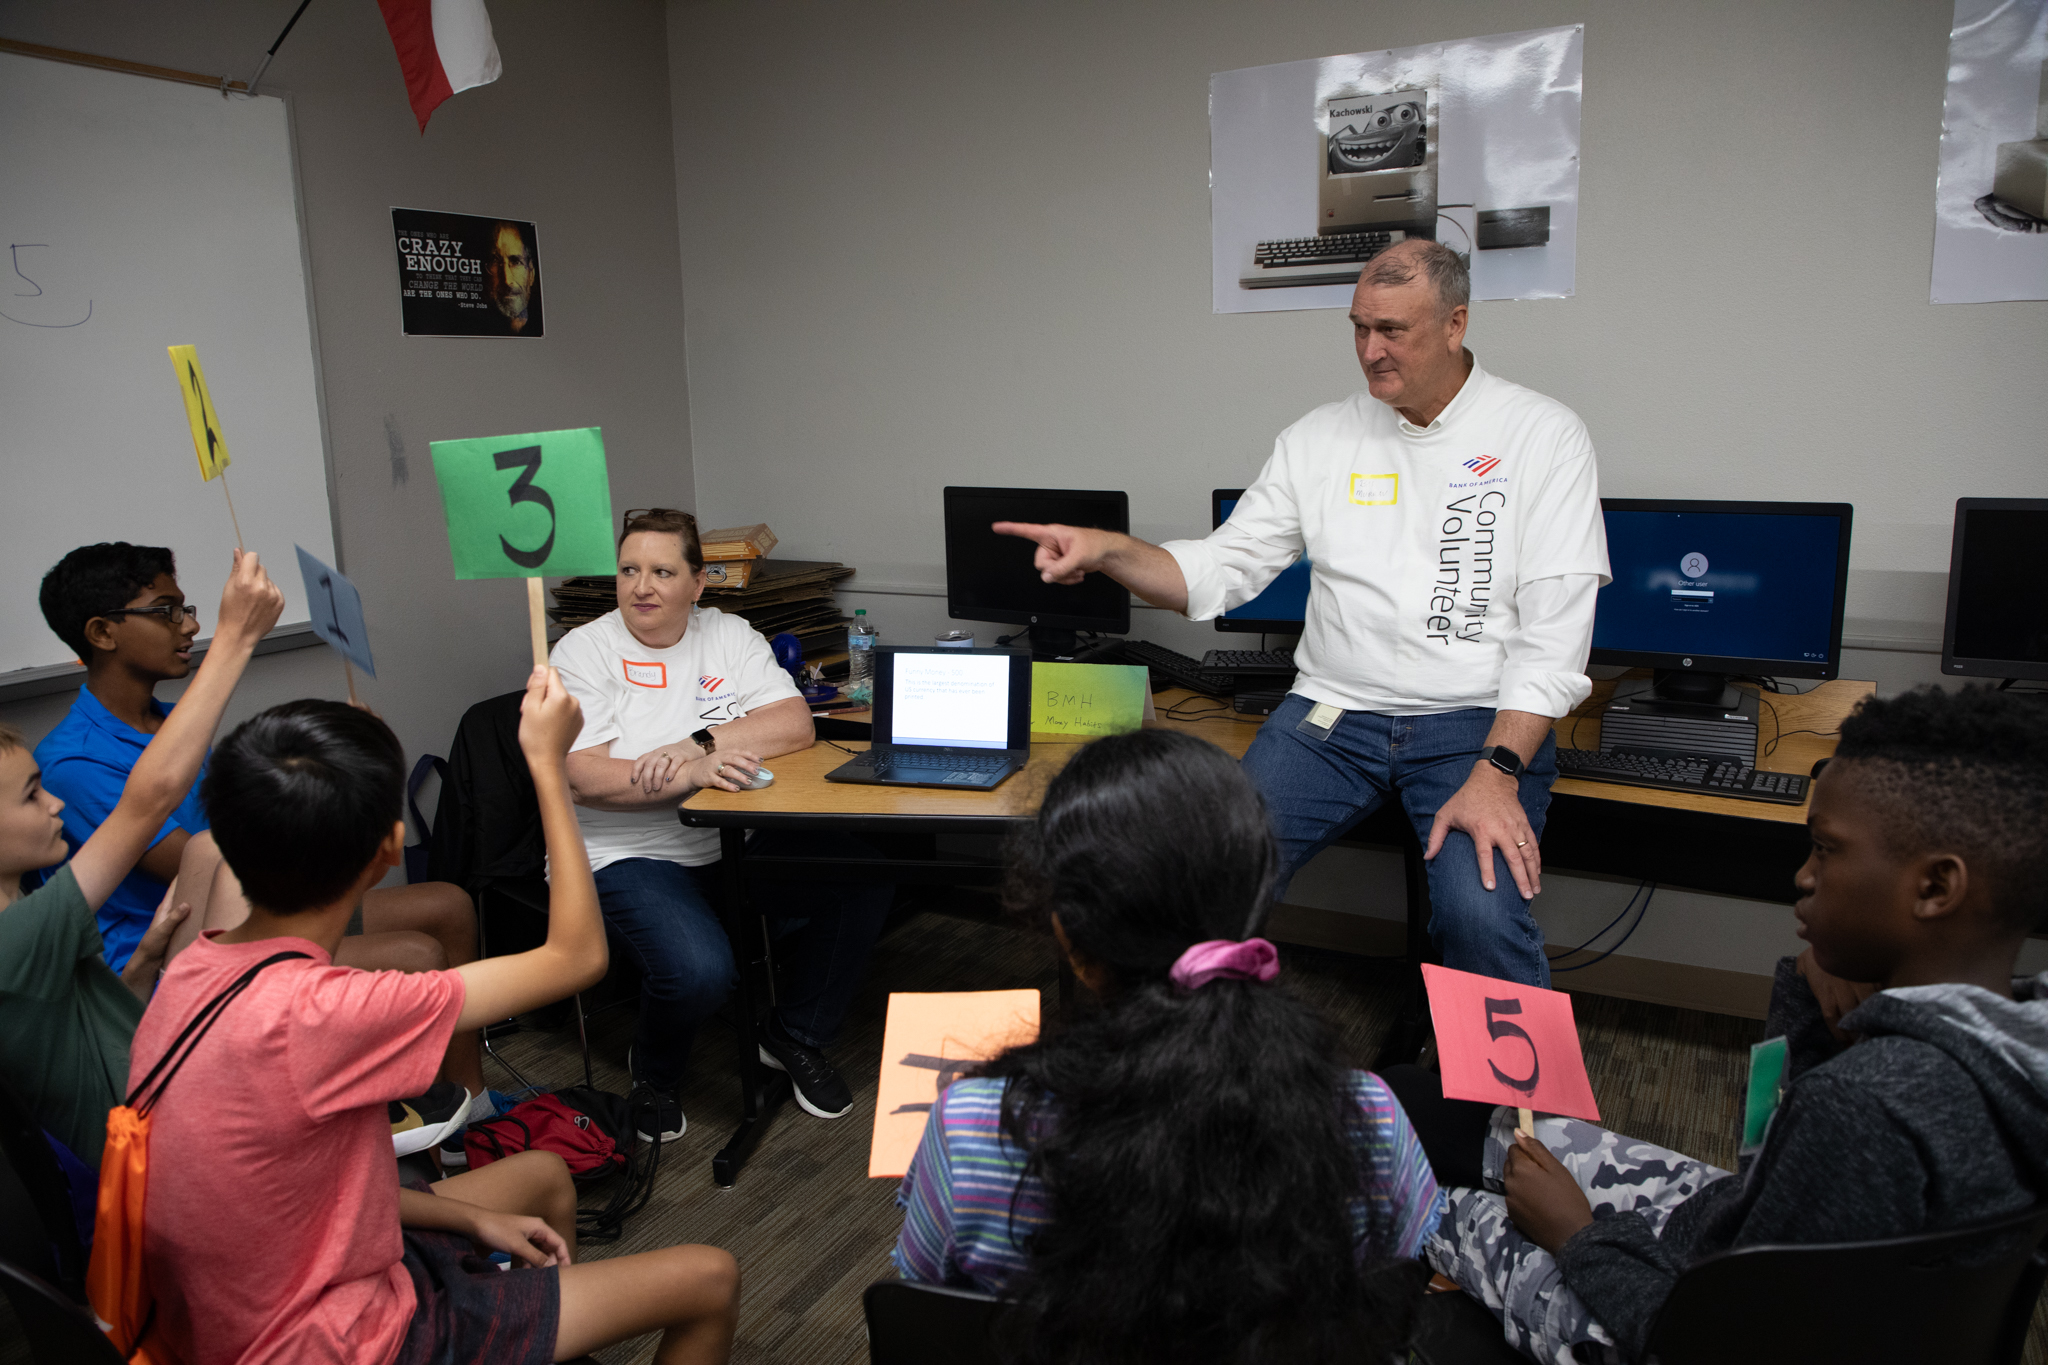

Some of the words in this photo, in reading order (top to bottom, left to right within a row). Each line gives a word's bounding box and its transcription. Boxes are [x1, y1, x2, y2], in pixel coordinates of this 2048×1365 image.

[1330, 105, 1373, 118] Kachowski
[398, 237, 463, 256] CRAZY
[10, 243, 49, 297] 5
[405, 255, 482, 274] ENOUGH
[409, 280, 439, 289] CHANGE
[443, 282, 458, 290] THE
[461, 283, 484, 291] WORLD
[403, 289, 416, 297] ARE
[419, 290, 433, 298] THE
[470, 292, 481, 300] DO.
[1479, 477, 1508, 486] AMERICA
[493, 445, 555, 569] 3
[1426, 494, 1477, 646] Volunteer
[1455, 491, 1506, 643] Community
[905, 668, 924, 677] Funny
[925, 668, 946, 677] Money
[932, 680, 949, 688] largest
[715, 692, 736, 700] AMERIC
[1047, 691, 1093, 708] BMH
[1074, 717, 1102, 729] Habits
[1484, 996, 1540, 1098] 5
